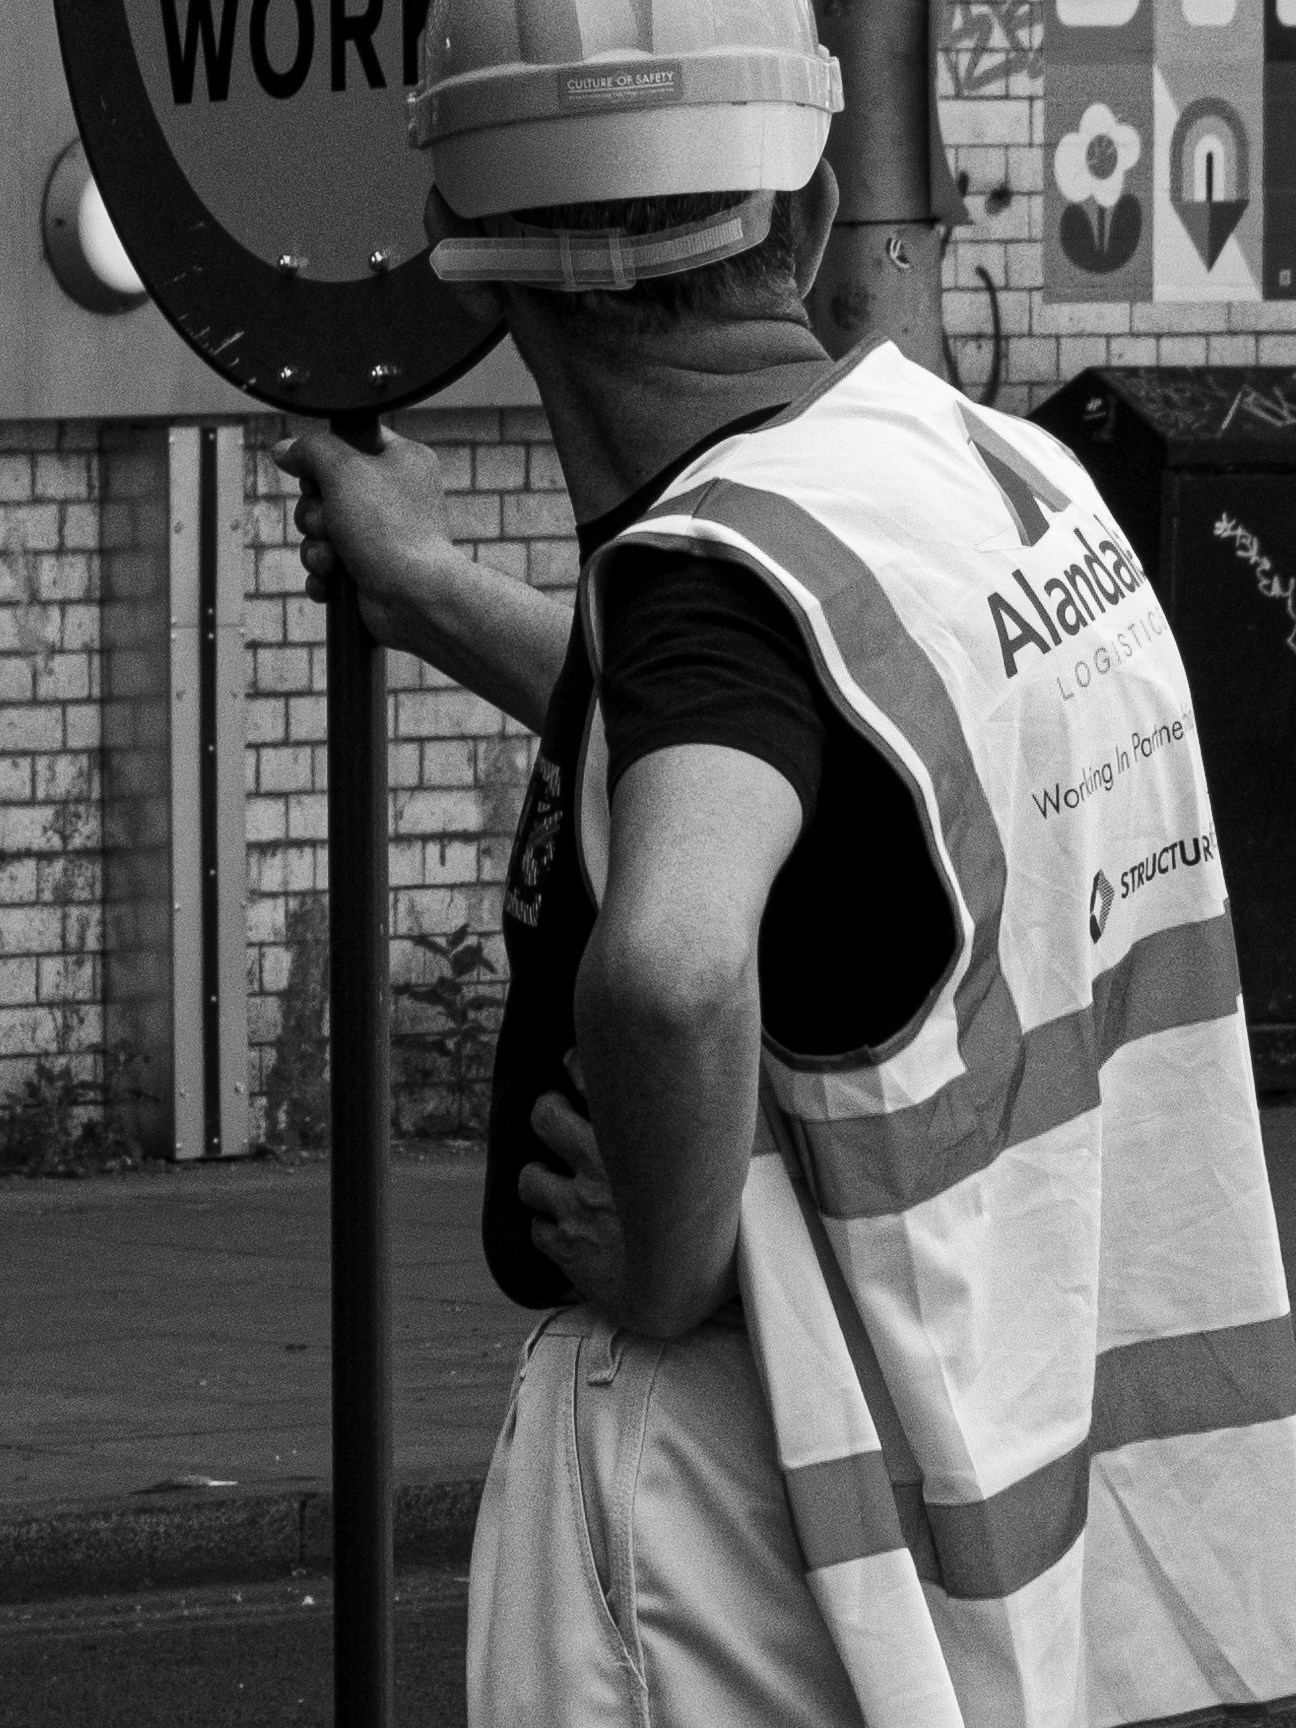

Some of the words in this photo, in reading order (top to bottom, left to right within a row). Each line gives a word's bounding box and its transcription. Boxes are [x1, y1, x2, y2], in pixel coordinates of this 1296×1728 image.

[567, 77, 613, 91] CULTURE
[616, 74, 633, 87] OF
[635, 71, 674, 85] SAFETY
[987, 514, 1146, 679] Alandal
[1115, 745, 1131, 775] In
[1120, 829, 1216, 899] STRUCTUR
